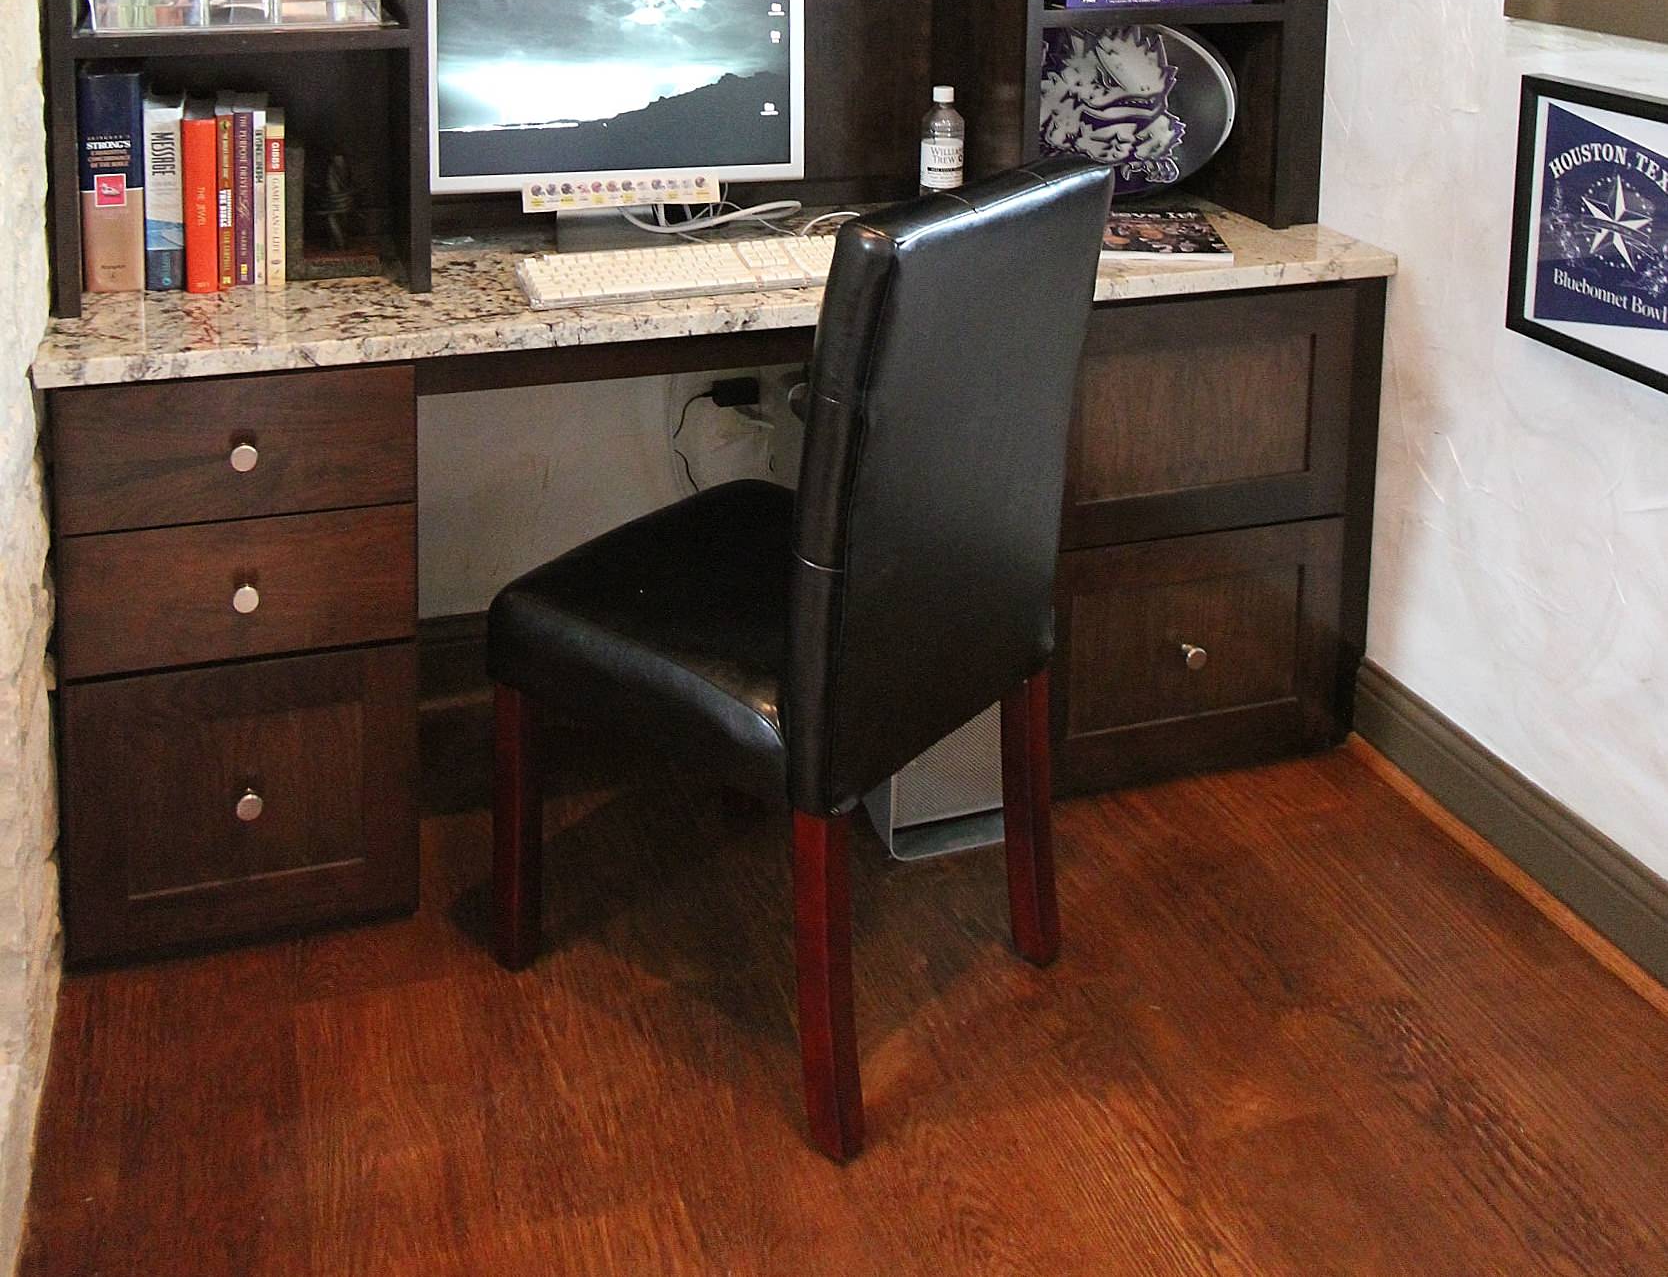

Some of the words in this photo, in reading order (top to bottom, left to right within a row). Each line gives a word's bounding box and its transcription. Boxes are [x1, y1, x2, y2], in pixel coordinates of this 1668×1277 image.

[151, 132, 176, 176] MESSAGE
[239, 130, 249, 162] PURPOSE
[271, 141, 280, 170] GIBBS
[1549, 142, 1632, 179] HOUSTON,
[271, 178, 281, 201] GAME
[271, 204, 281, 226] PLAN
[1553, 268, 1628, 310] Bluebonnet
[1631, 295, 1668, 324] Bowl
